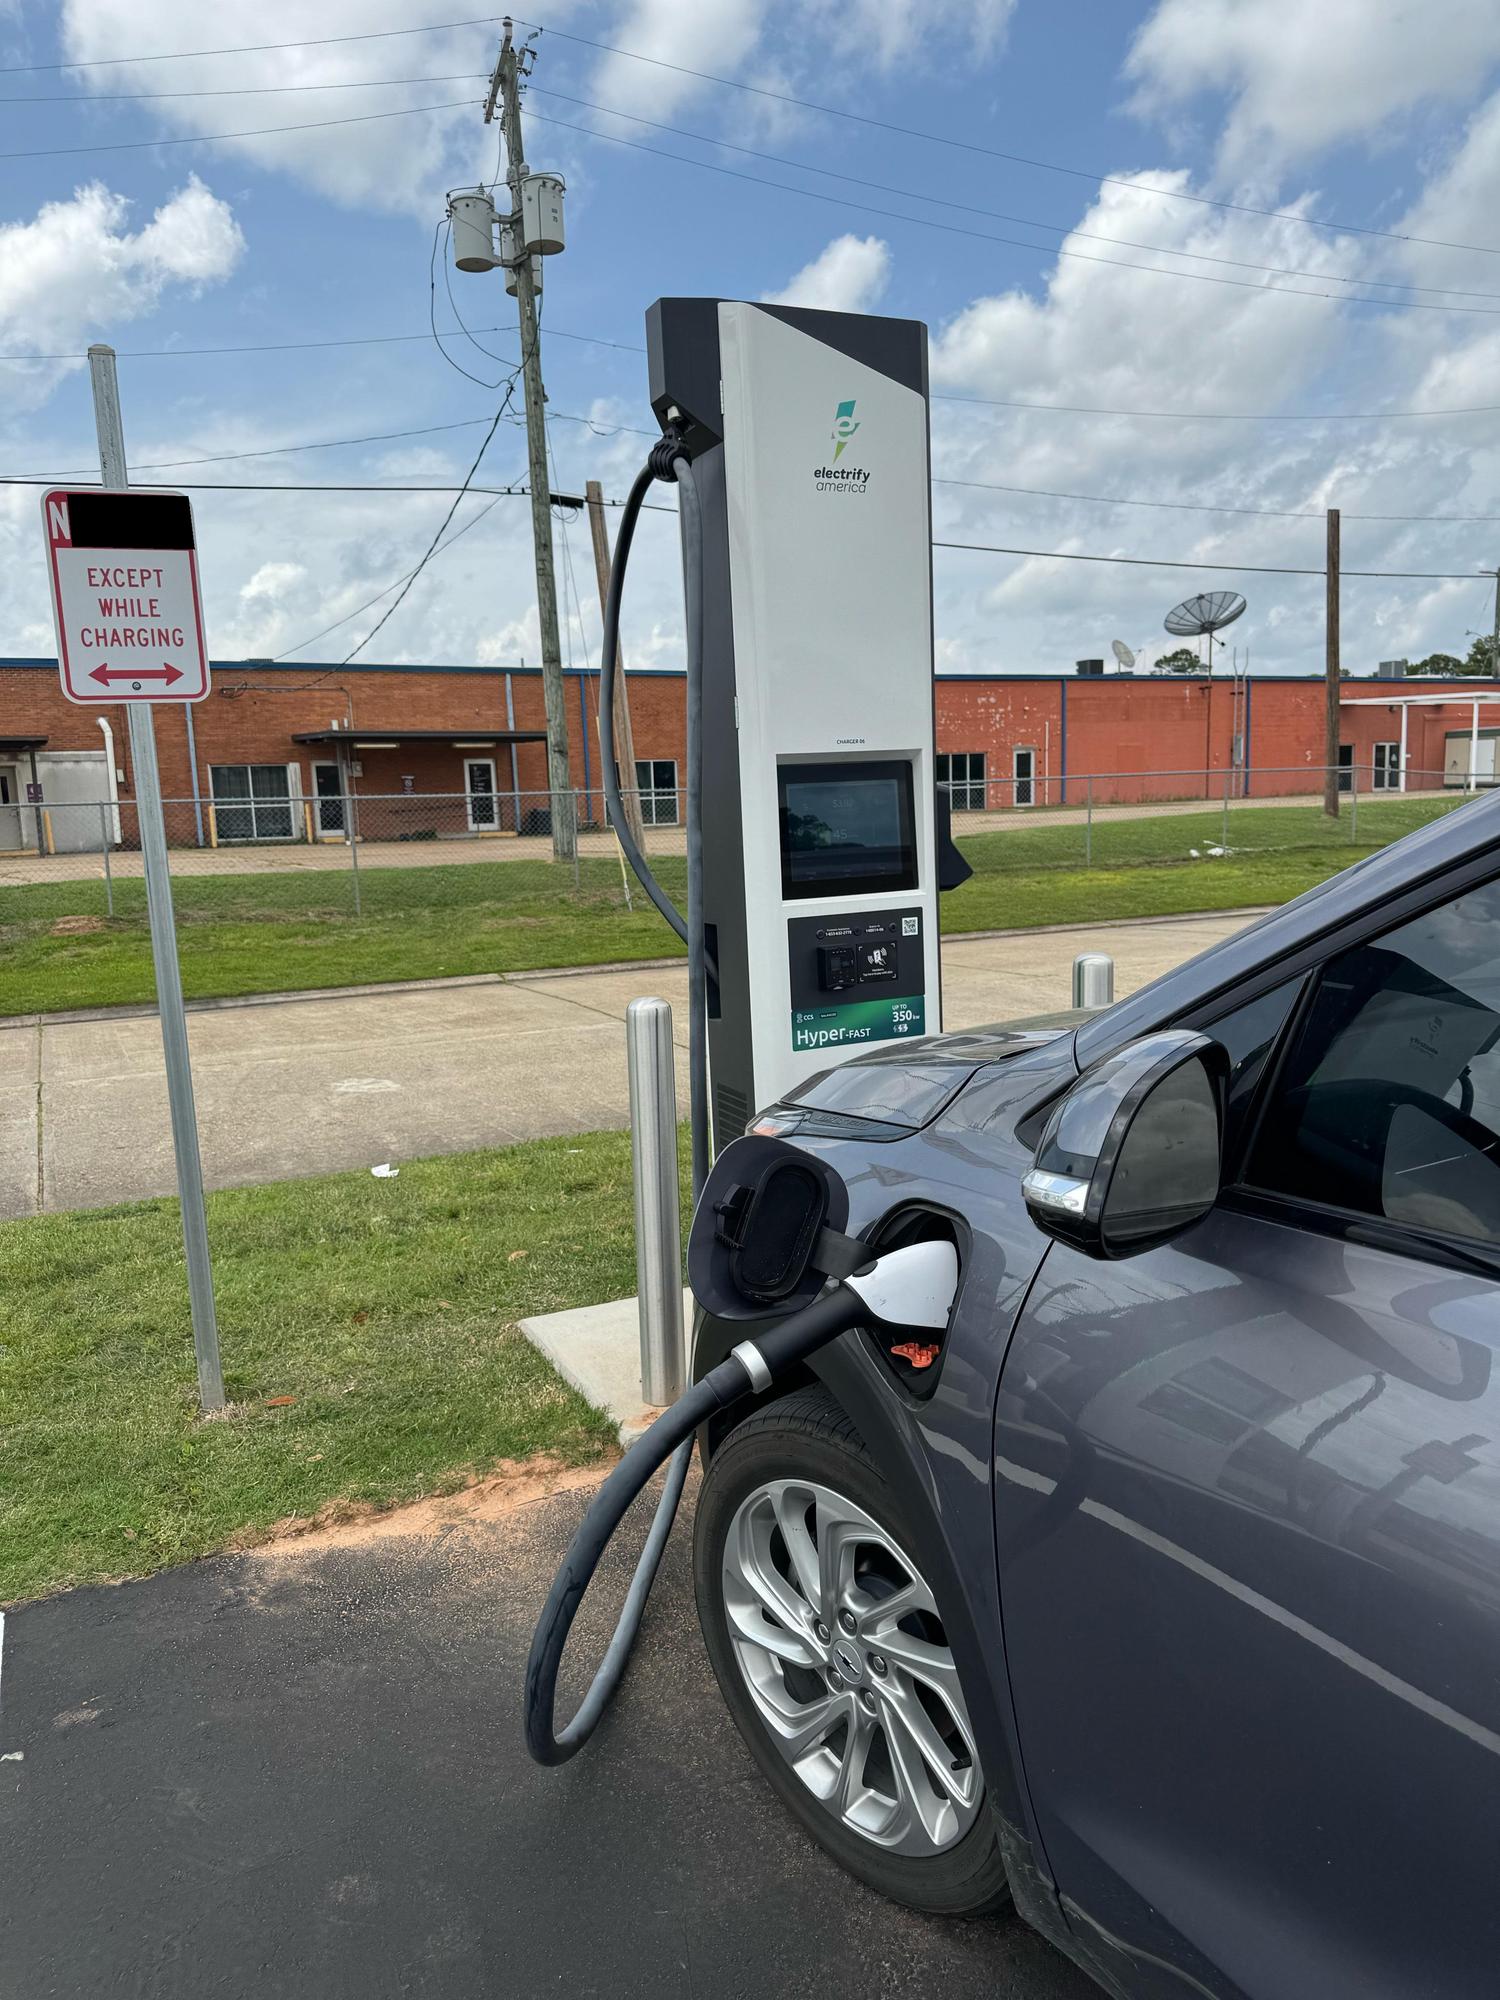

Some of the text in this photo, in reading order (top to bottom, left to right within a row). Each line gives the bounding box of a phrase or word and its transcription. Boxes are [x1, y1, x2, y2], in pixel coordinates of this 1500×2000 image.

[814, 467, 870, 483] electrify
[816, 482, 866, 493] america
[87, 568, 163, 588] EXCEPT
[98, 598, 161, 618] WHILE
[80, 628, 184, 648] CHARGING
[892, 1010, 912, 1022] 350
[797, 1028, 871, 1047] Hyper-FAST
